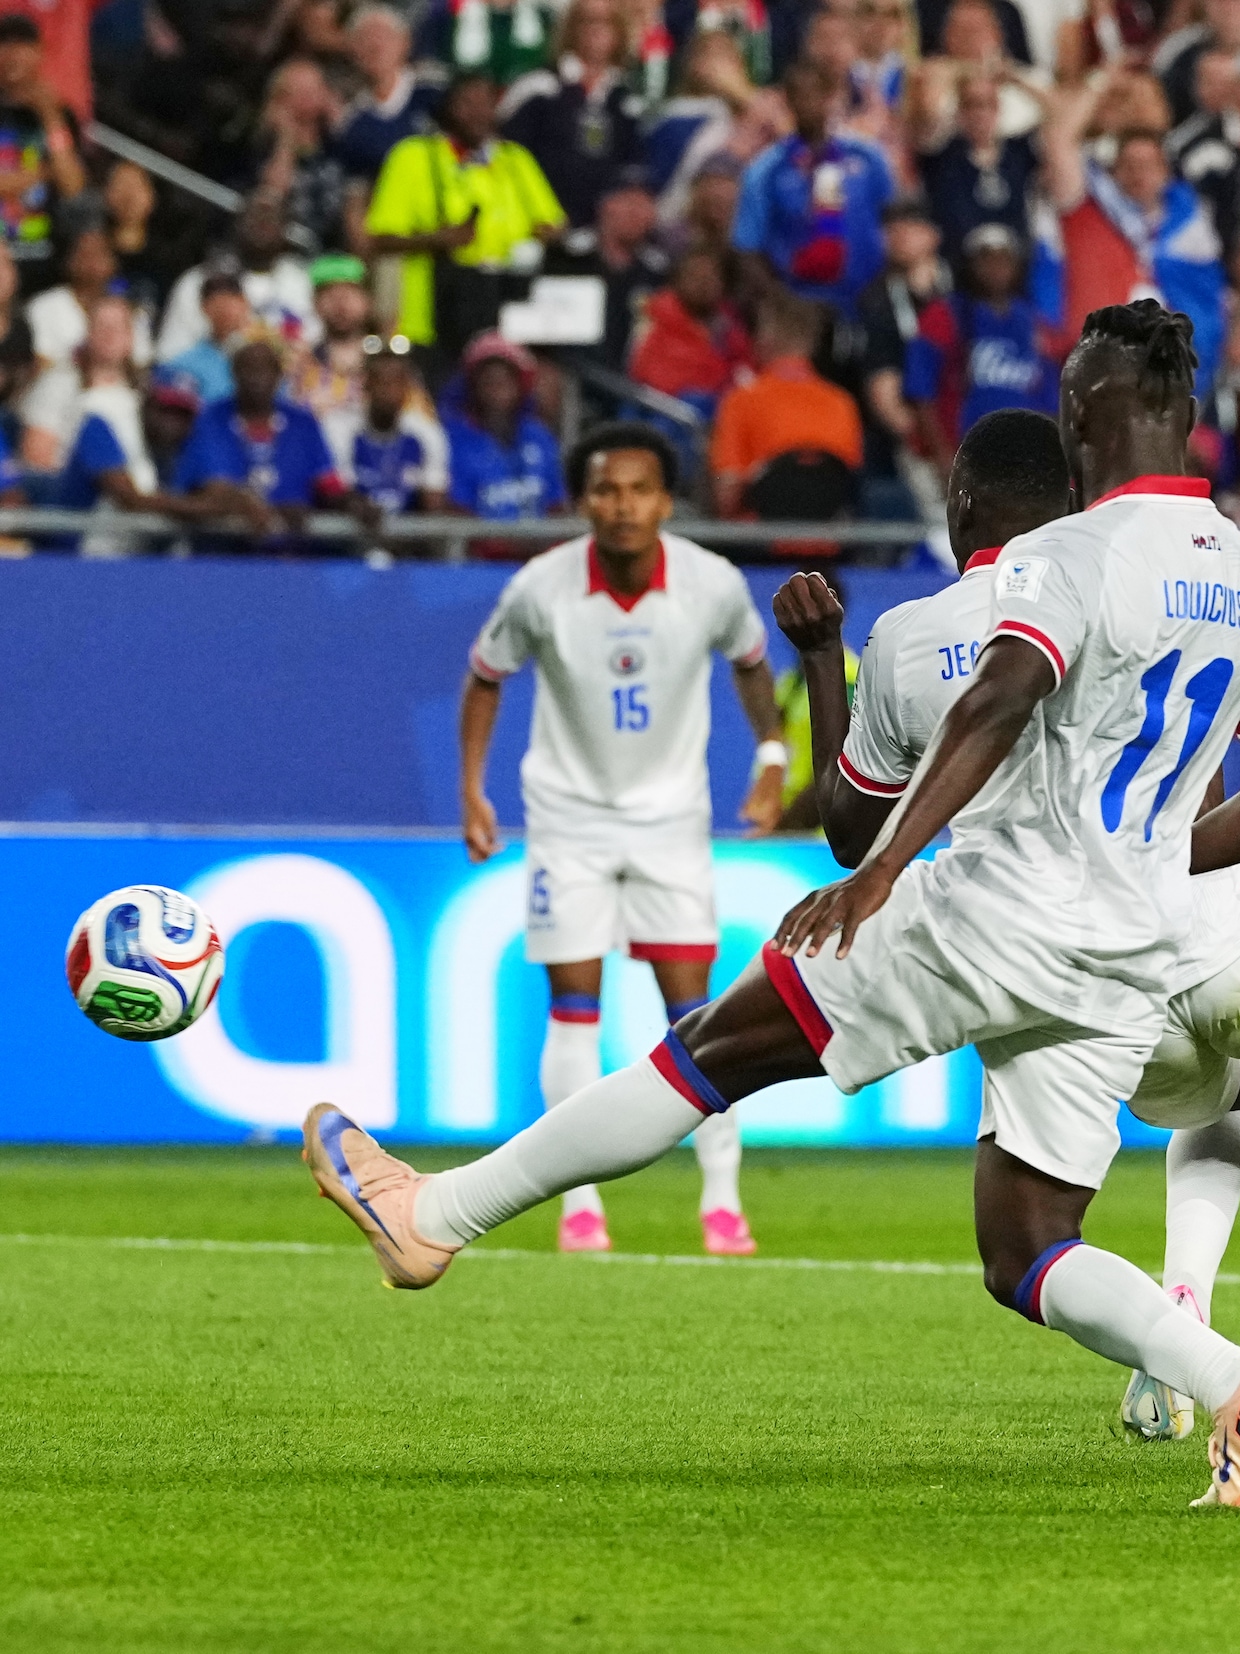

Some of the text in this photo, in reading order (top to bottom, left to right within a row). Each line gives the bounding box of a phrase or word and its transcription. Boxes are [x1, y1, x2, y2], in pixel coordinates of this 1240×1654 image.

[1191, 533, 1222, 551] HAITI
[612, 684, 651, 732] 15
[1101, 648, 1235, 844] 11
